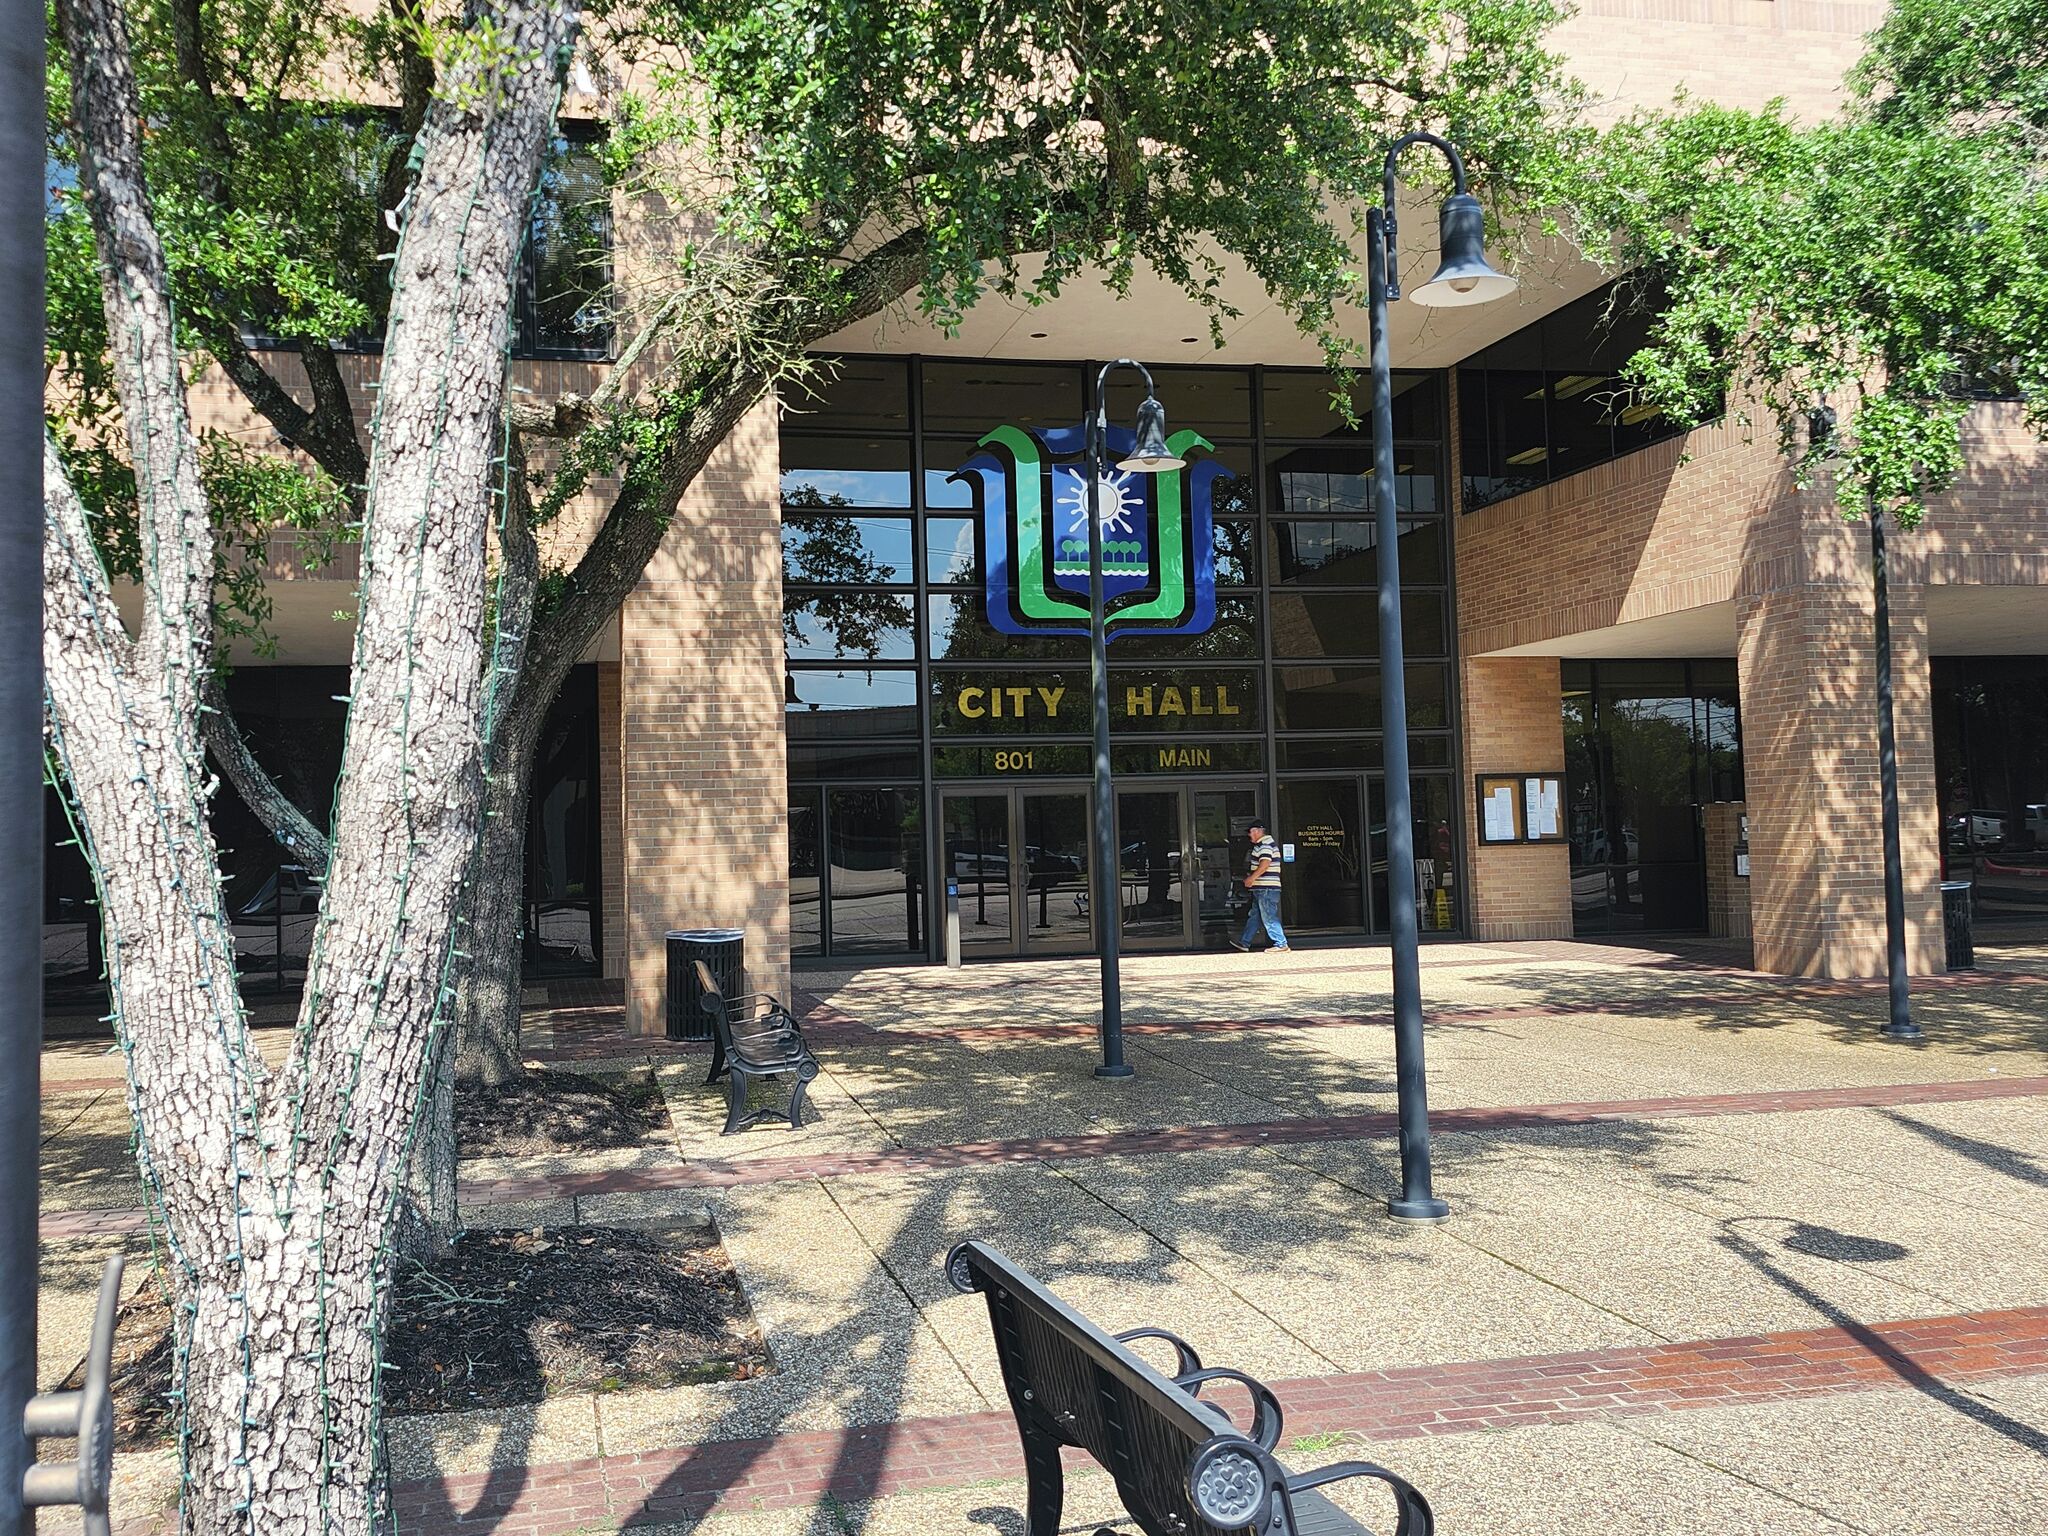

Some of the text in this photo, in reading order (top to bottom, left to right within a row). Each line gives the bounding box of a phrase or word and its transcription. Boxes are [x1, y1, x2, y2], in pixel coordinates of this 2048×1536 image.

[957, 686, 1240, 718] CITY HALL
[994, 749, 1211, 770] 801 MAIN
